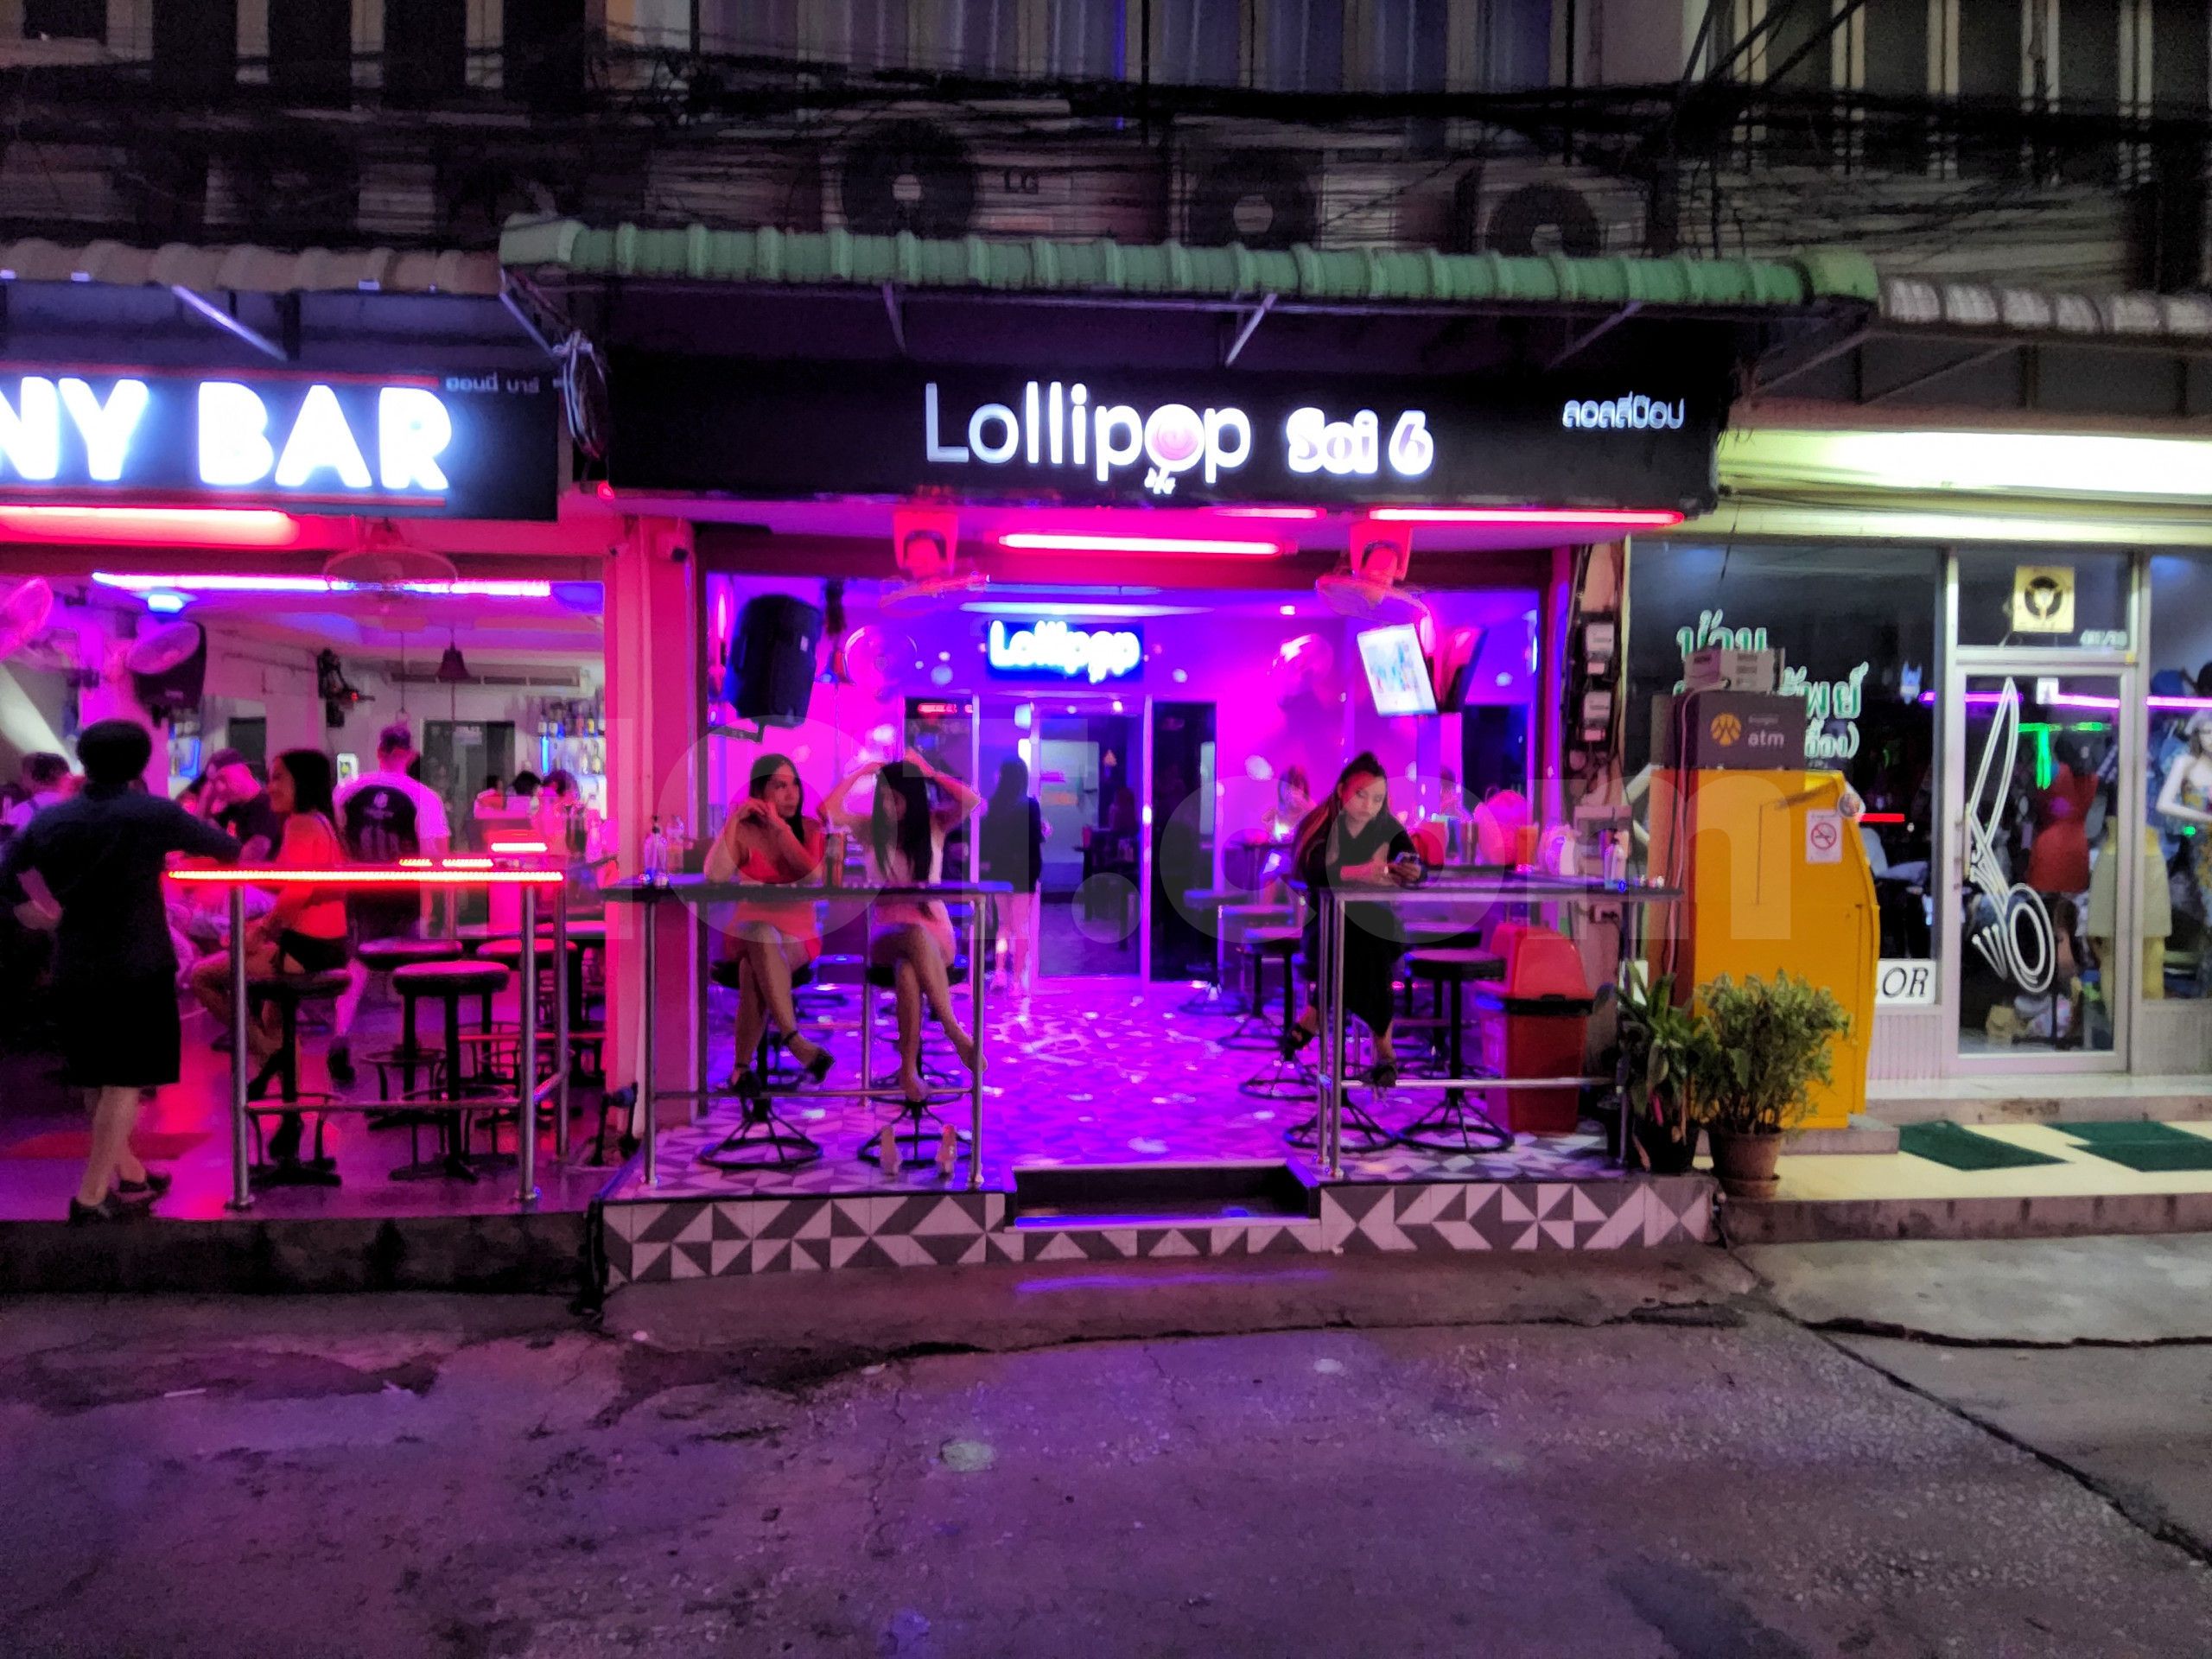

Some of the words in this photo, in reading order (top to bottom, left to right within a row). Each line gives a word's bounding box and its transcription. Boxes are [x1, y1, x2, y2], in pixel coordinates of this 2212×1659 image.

[198, 381, 452, 489] BAR
[926, 381, 1251, 486] Lollipop
[1286, 407, 1378, 475] Soi
[1388, 409, 1434, 476] 6
[1747, 728, 1785, 748] atm
